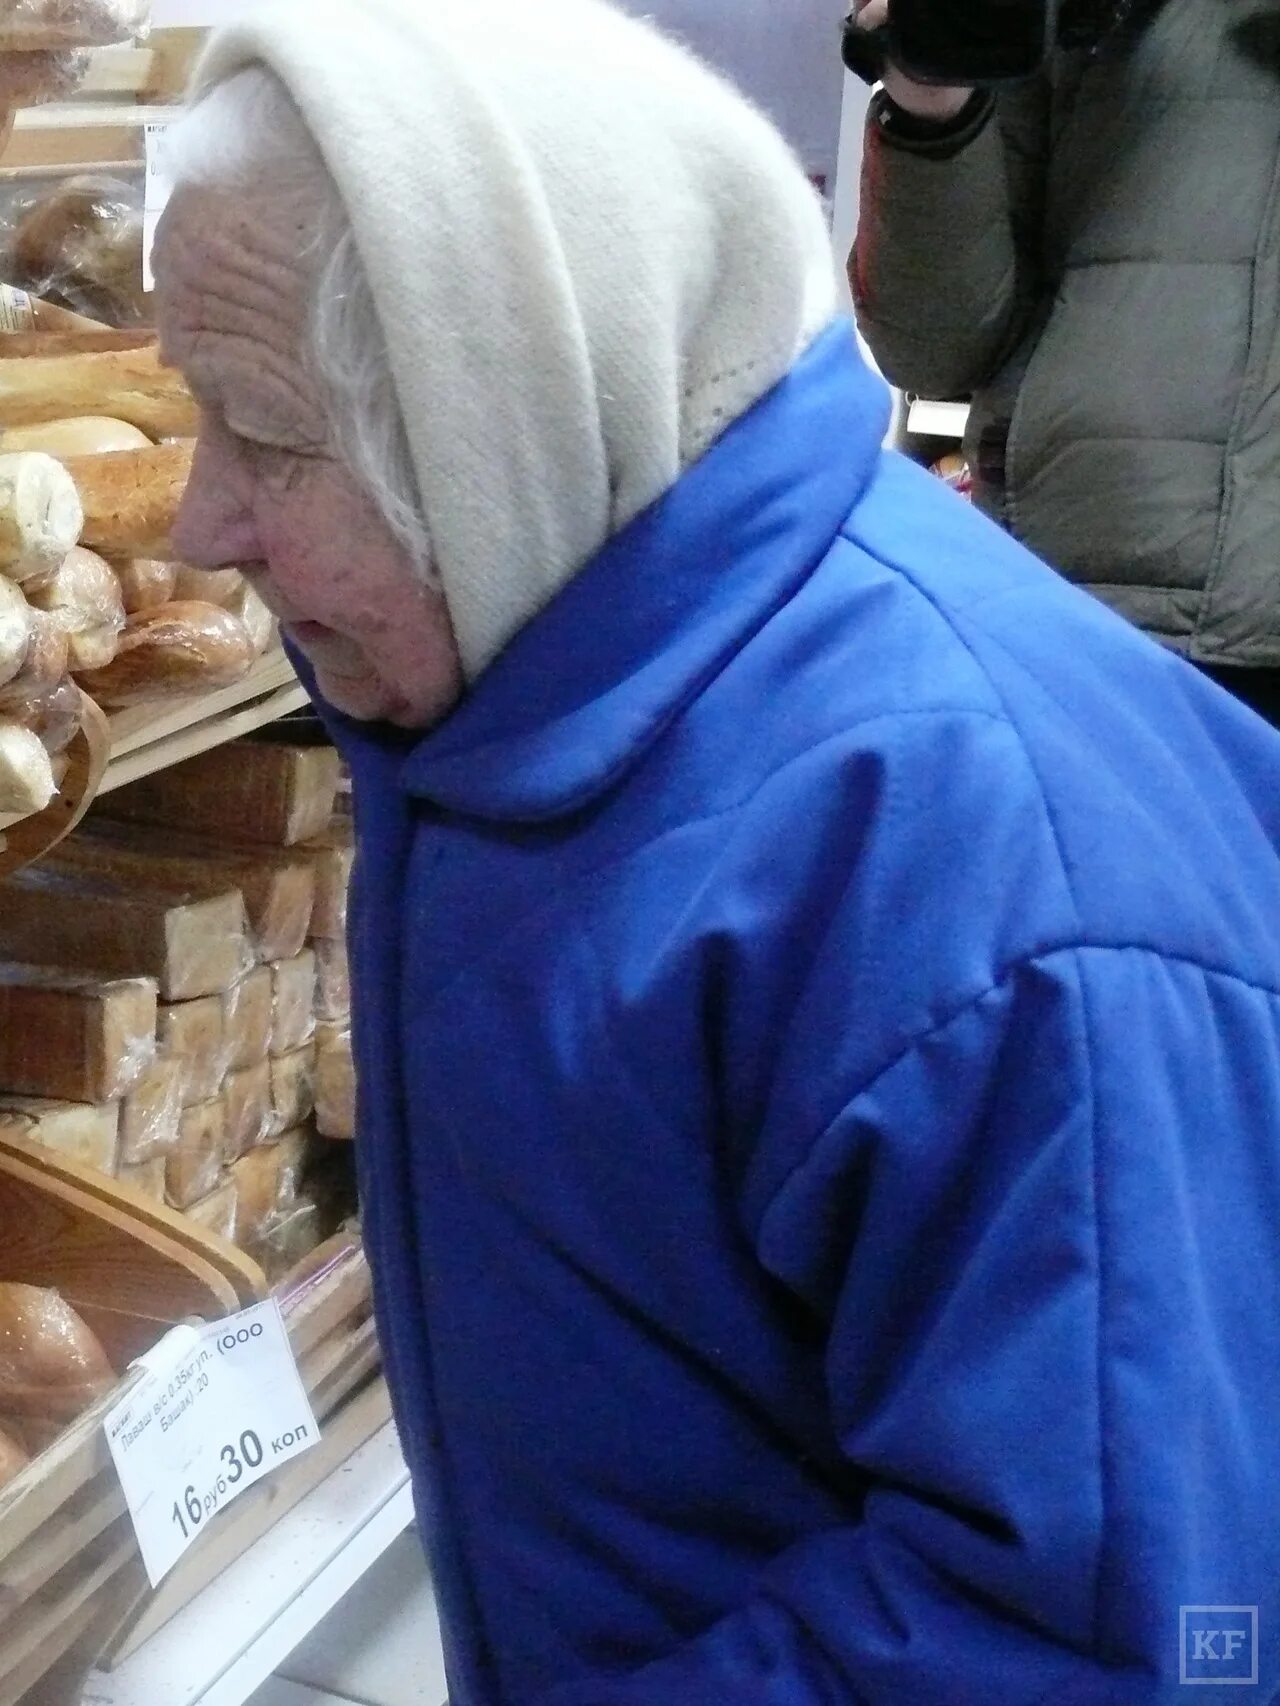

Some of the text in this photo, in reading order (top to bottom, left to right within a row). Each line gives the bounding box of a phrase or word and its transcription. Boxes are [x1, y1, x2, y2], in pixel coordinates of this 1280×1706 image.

[217, 1322, 264, 1356] (ООО
[172, 1424, 309, 1538] 16 руб 30 коп
